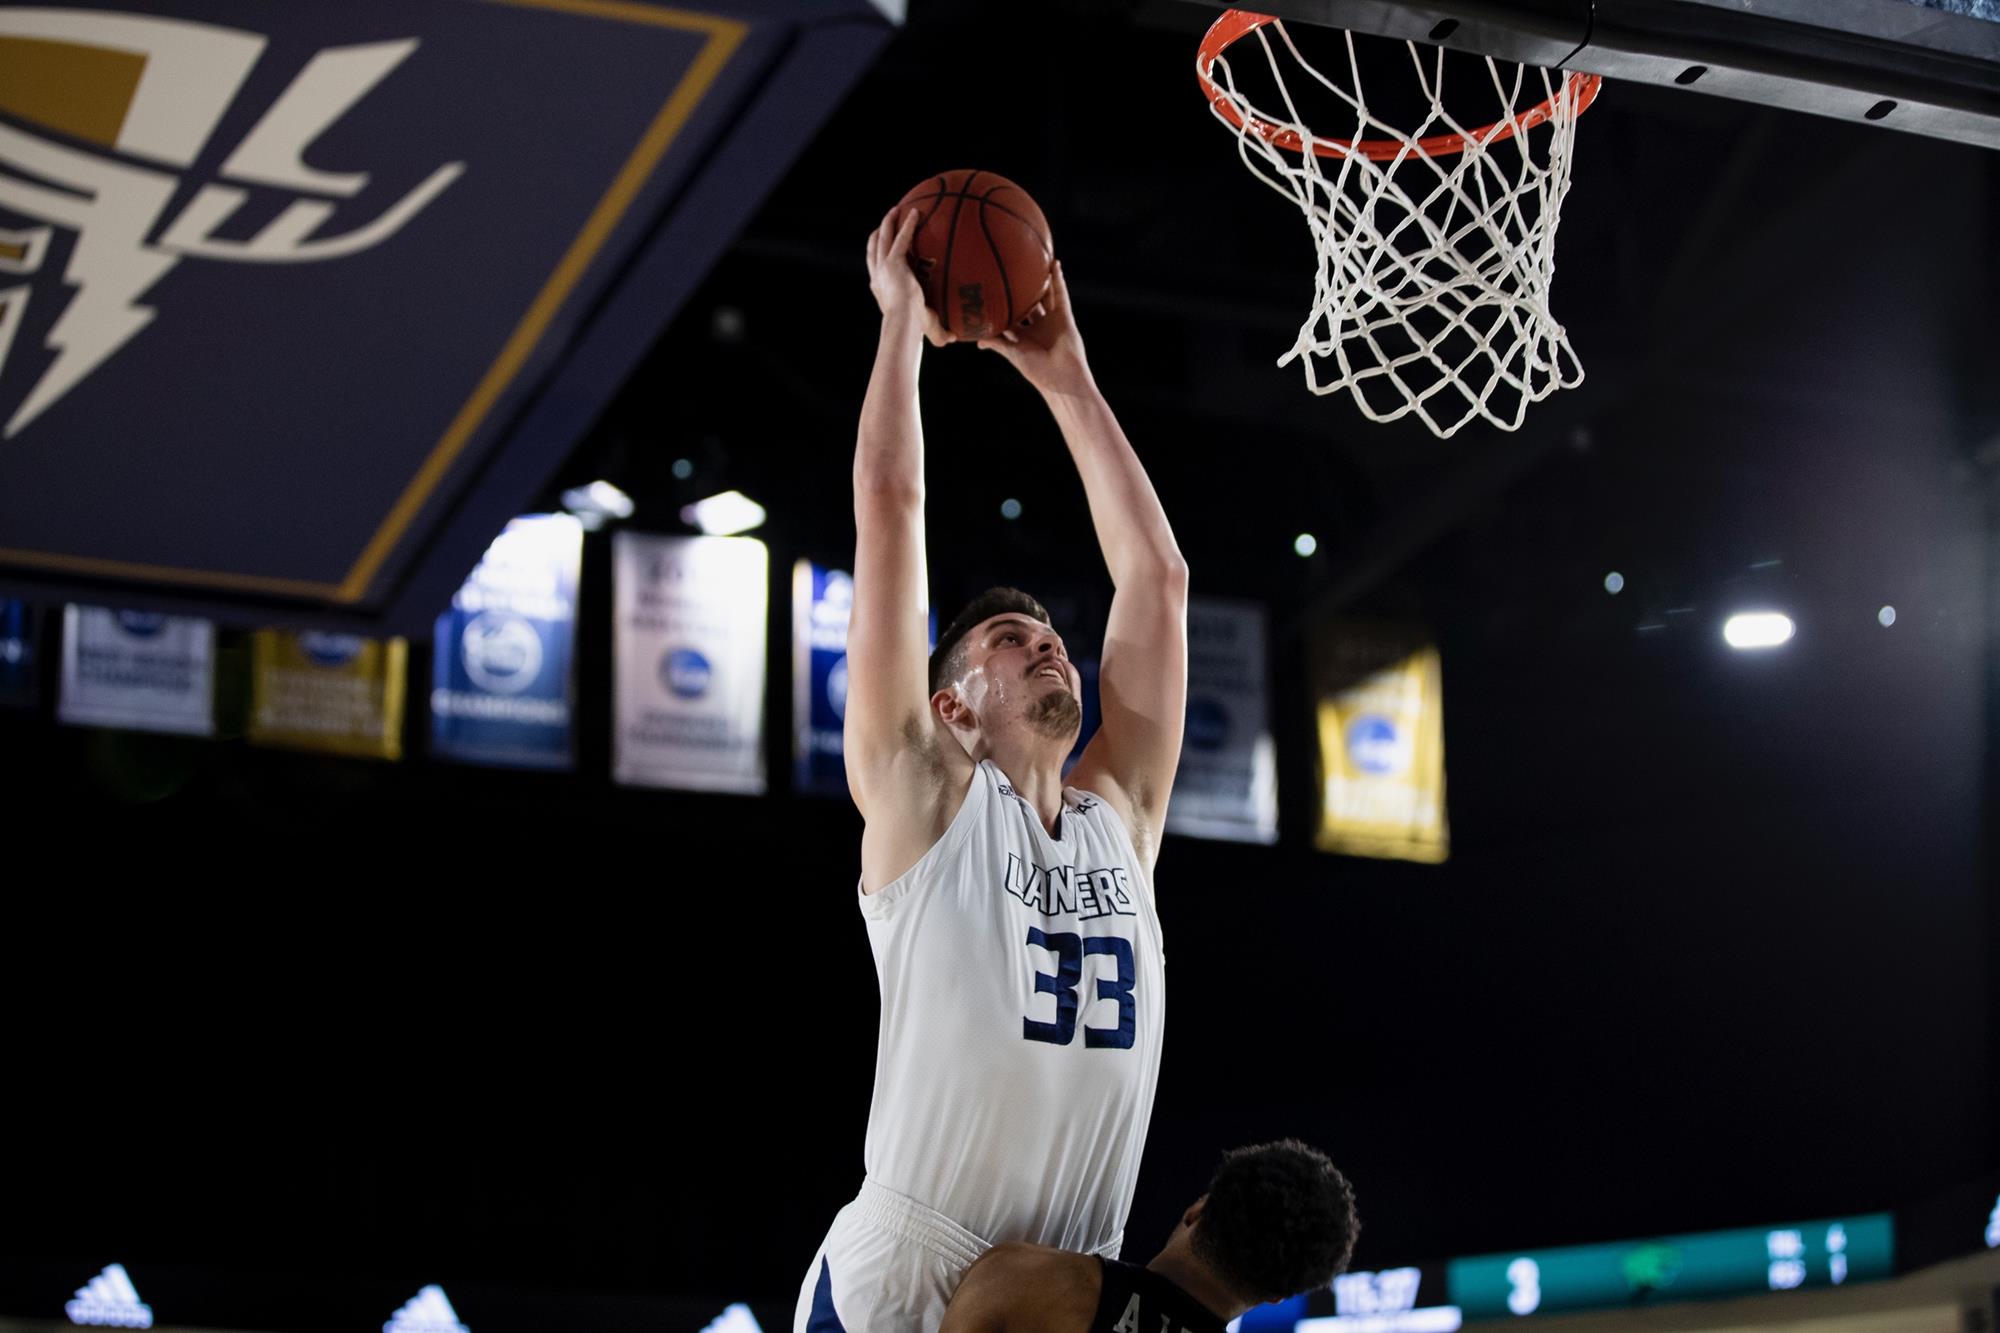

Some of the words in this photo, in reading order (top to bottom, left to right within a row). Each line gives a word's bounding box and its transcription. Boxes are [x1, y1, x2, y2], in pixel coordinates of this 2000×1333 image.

[1005, 852, 1137, 921] LANERS
[1023, 926, 1136, 1050] 33
[1507, 1257, 1541, 1316] 3
